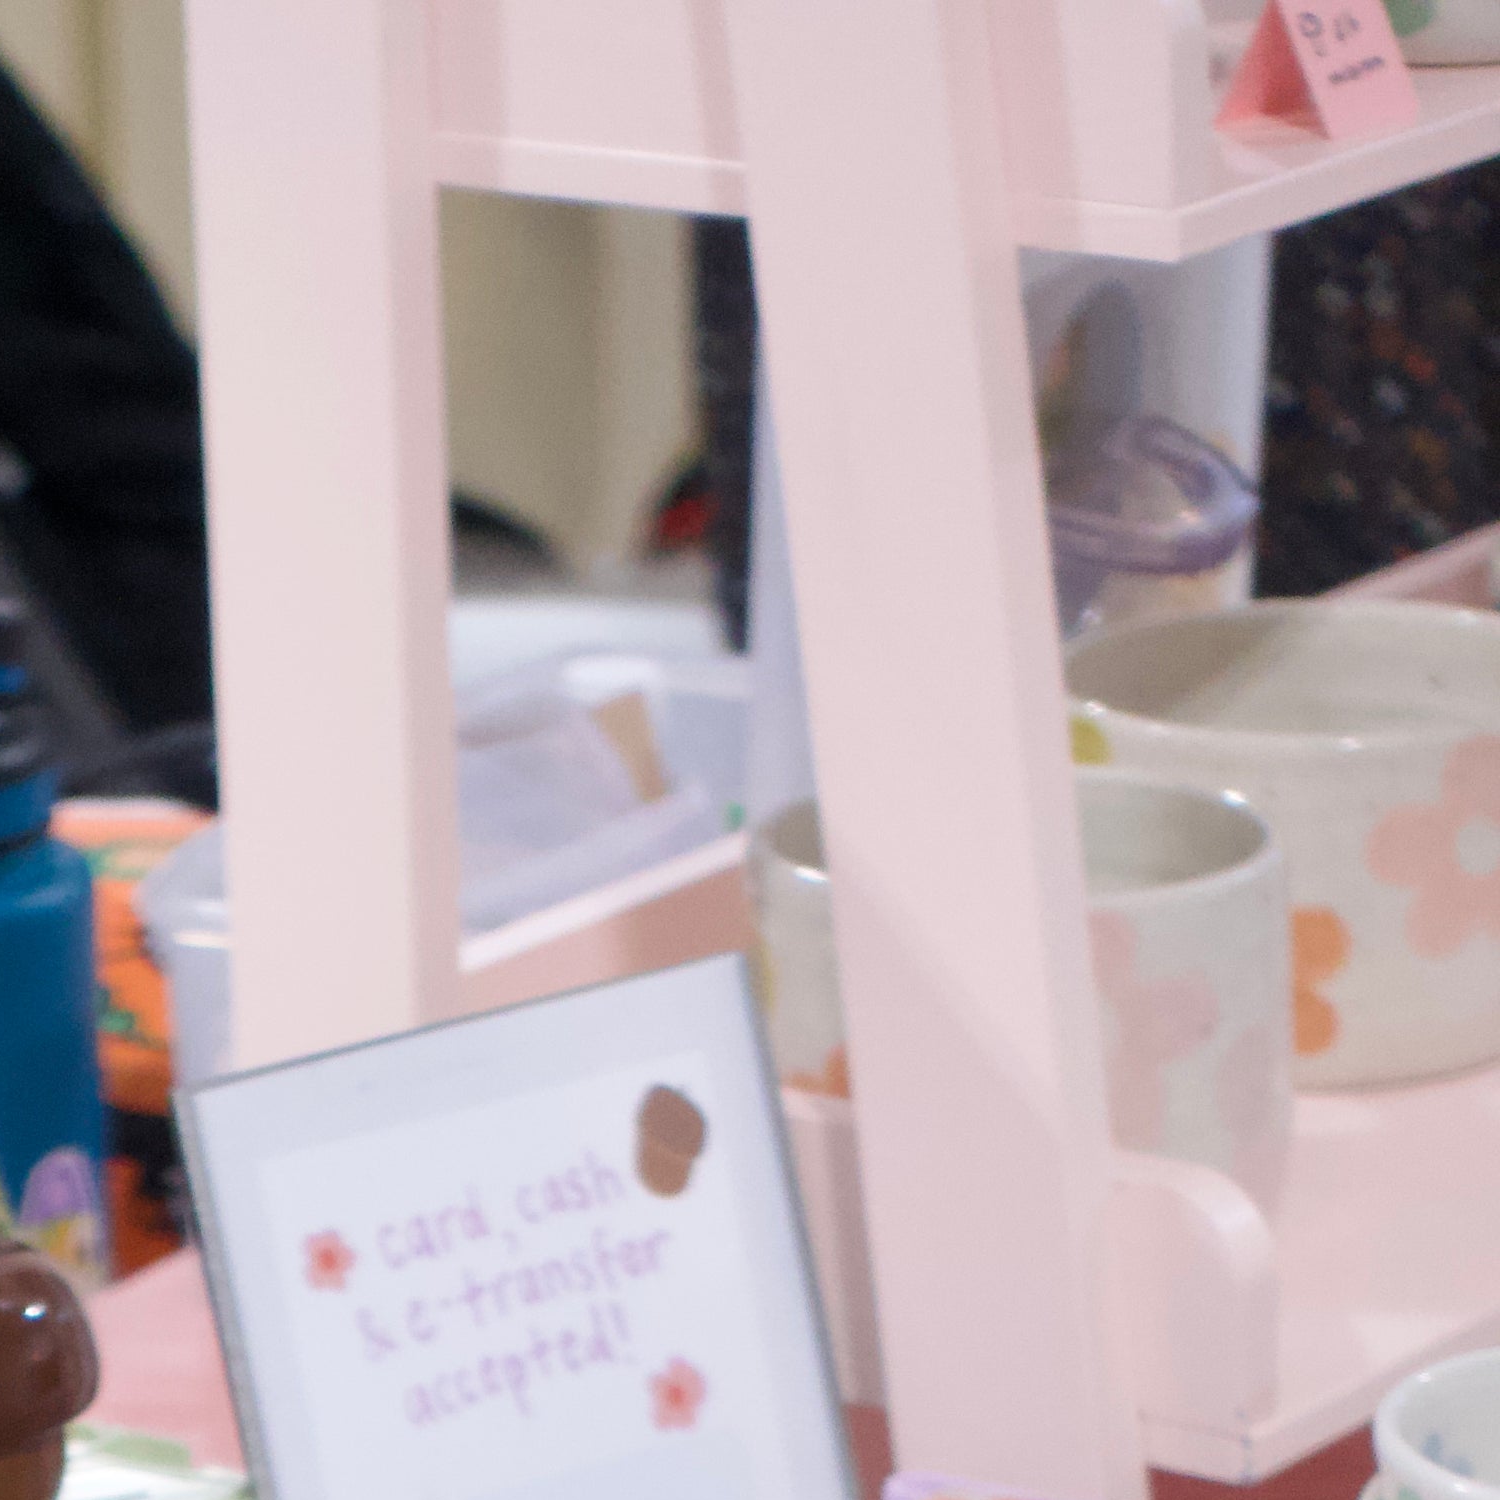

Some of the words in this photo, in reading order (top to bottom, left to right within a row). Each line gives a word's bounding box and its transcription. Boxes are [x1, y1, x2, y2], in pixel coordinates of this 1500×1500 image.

[514, 1148, 627, 1225] cash
[405, 1226, 671, 1343] e-transfer
[403, 1299, 638, 1426] accepted!
